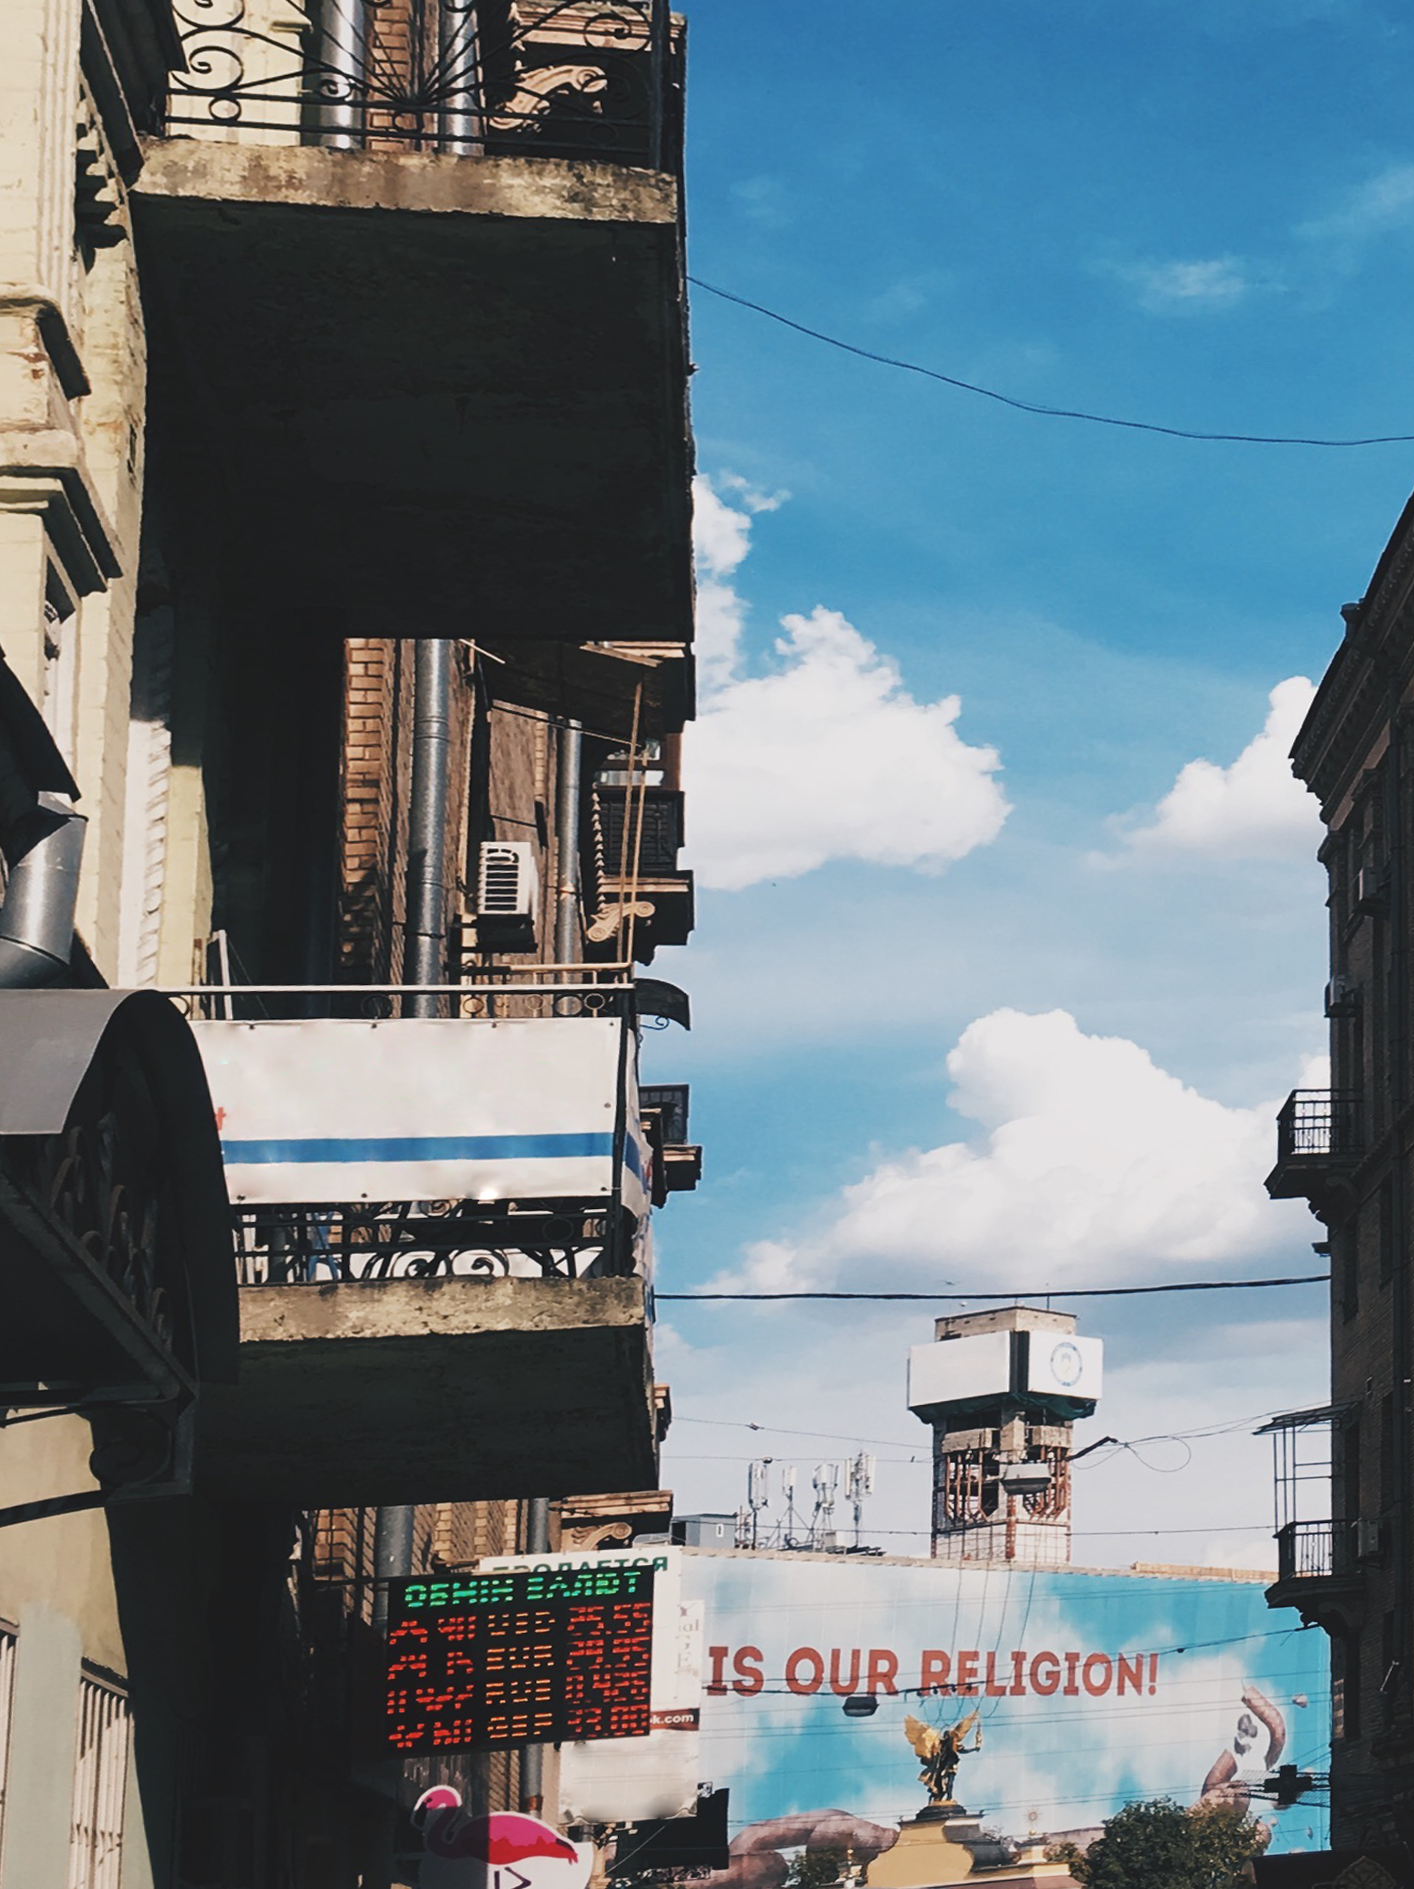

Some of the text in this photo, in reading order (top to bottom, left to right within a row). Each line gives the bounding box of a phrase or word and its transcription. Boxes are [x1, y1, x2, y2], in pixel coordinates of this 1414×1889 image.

[707, 1646, 1158, 1697] IS OUR RELIGION!
[650, 1714, 694, 1725] k.com
